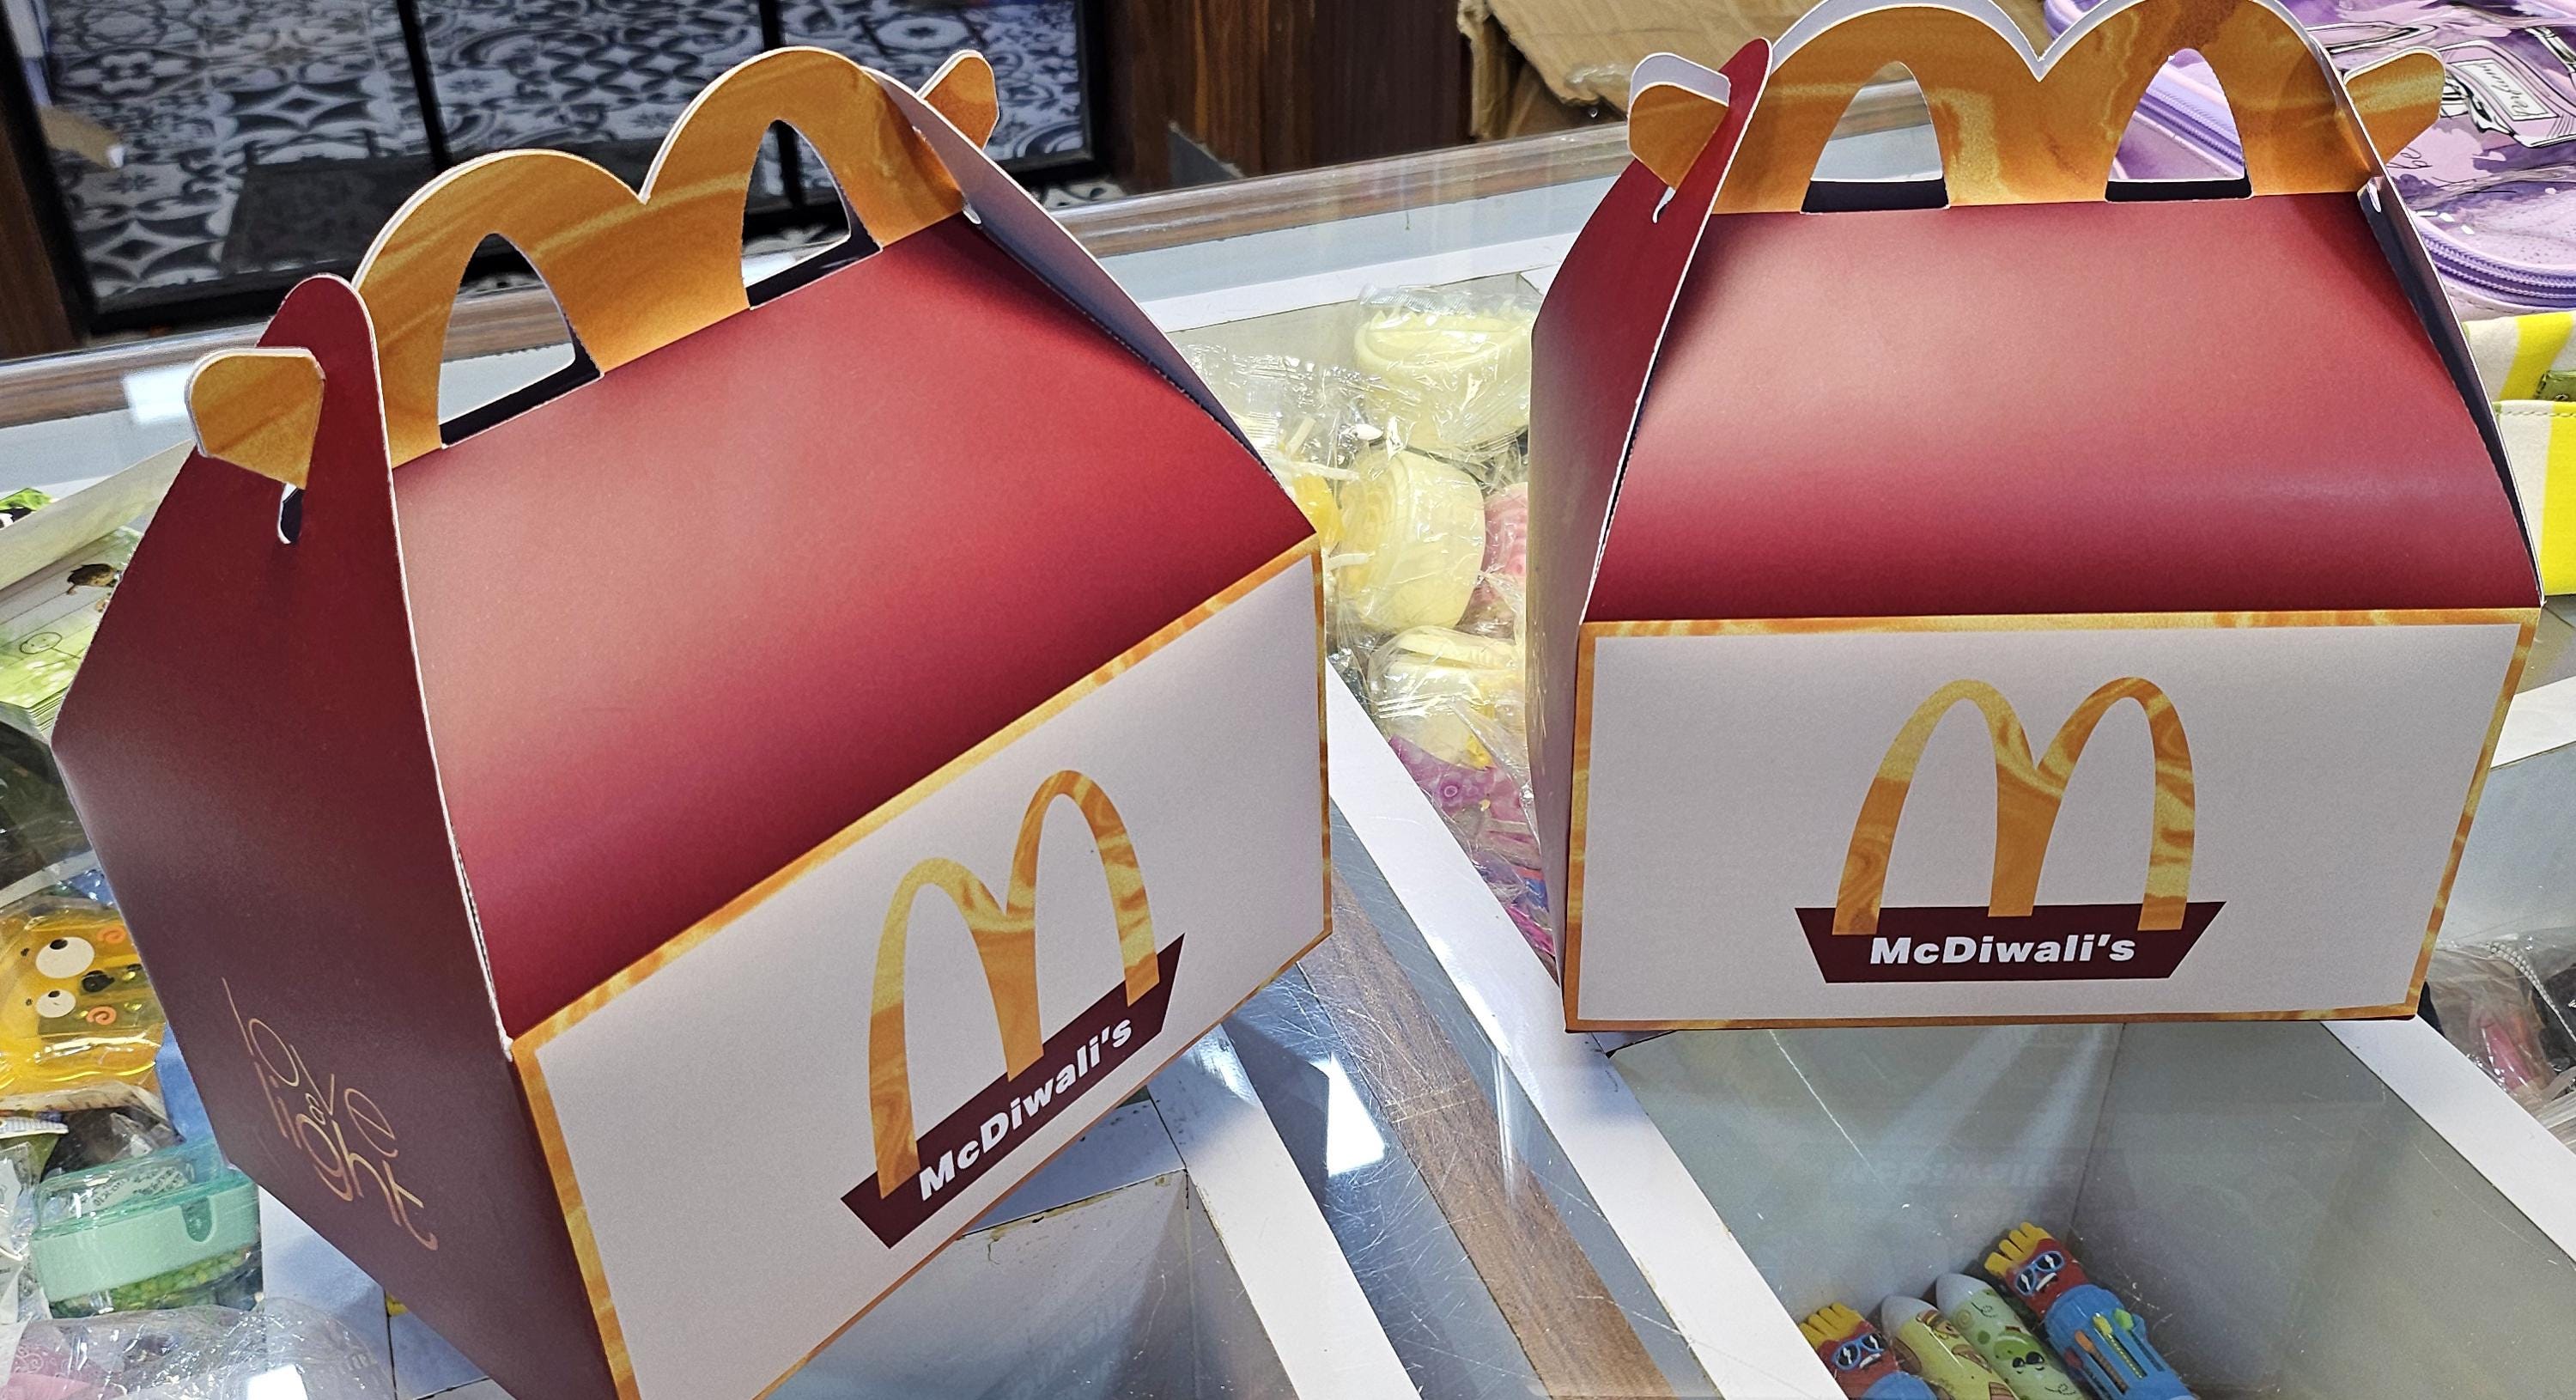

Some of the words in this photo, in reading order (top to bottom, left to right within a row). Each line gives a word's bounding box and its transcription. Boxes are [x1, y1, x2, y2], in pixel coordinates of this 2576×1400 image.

[1869, 934, 2136, 965] McDiwali's
[221, 976, 399, 1159] love
[253, 1061, 440, 1251] light
[919, 1019, 1133, 1202] McDiwali's
